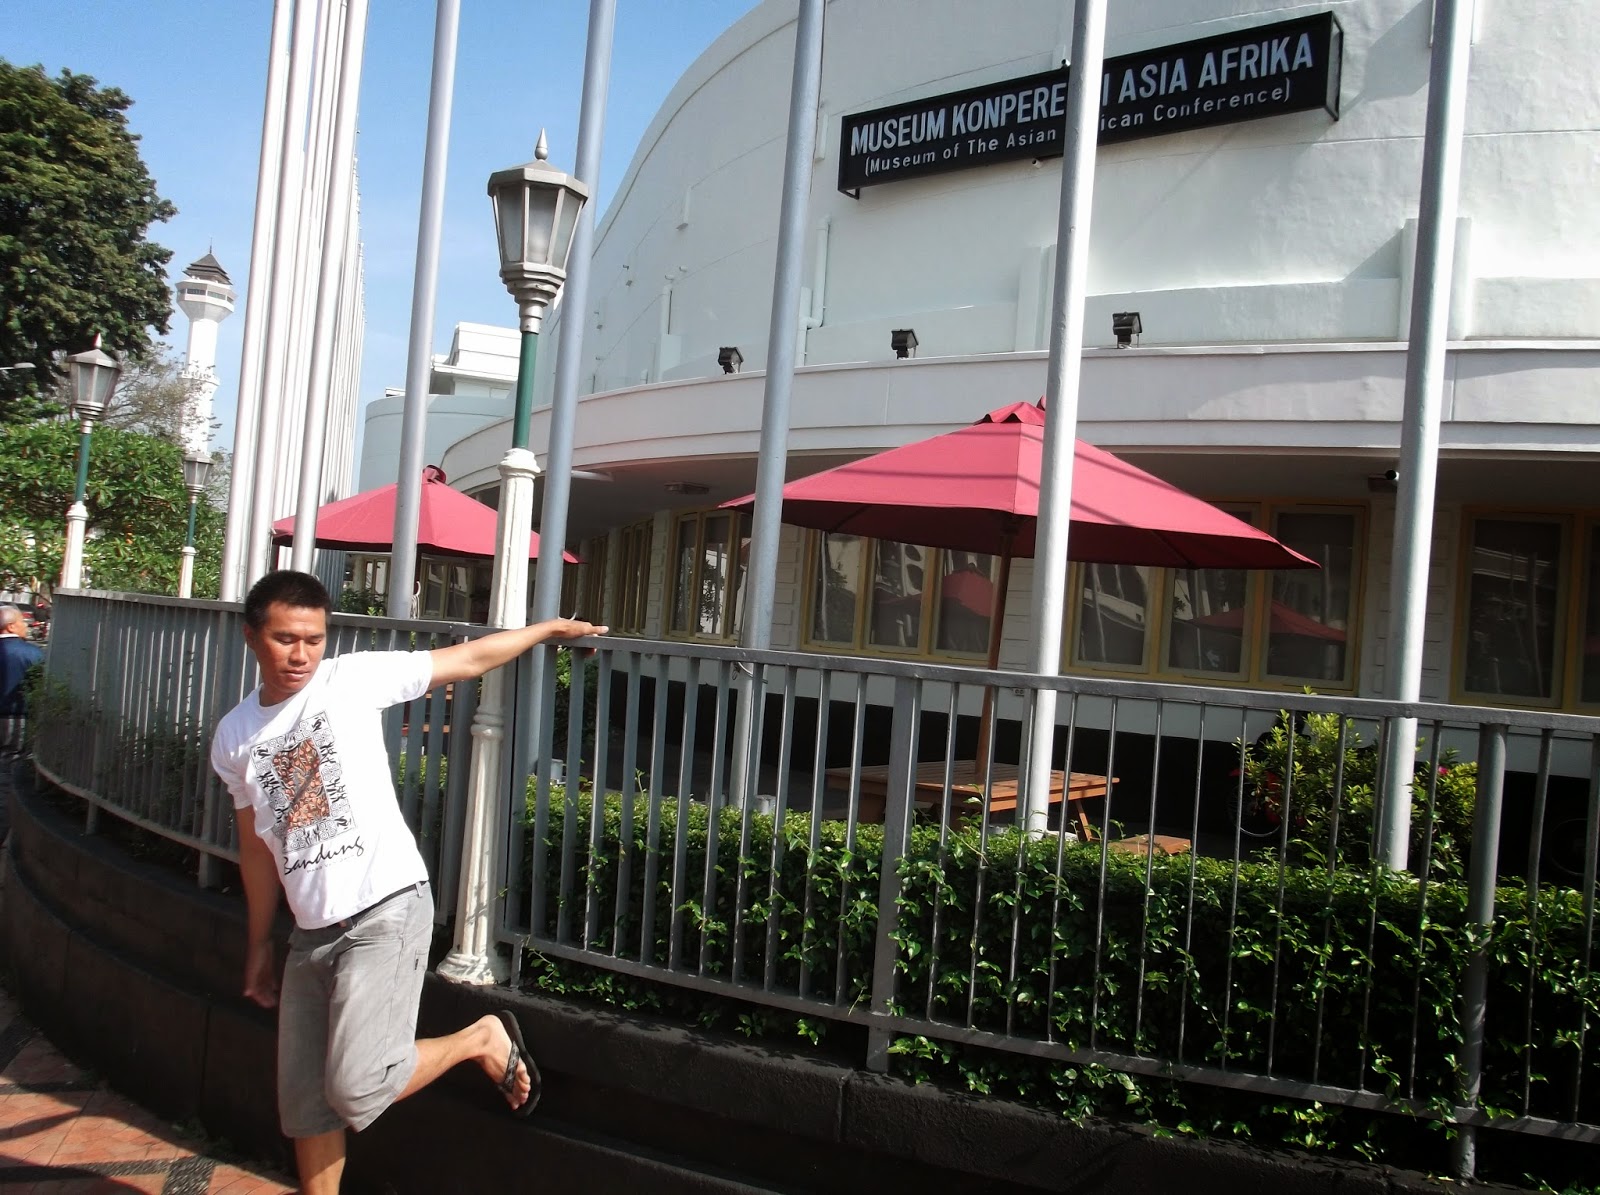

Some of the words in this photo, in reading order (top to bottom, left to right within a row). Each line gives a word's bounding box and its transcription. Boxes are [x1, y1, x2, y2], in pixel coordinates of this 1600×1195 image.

[850, 108, 946, 156] MUSEUM
[951, 73, 1110, 136] KONPEREI
[1118, 58, 1188, 104] ASIA
[1198, 32, 1314, 89] AFRIKA
[865, 151, 936, 177] (Museum
[943, 143, 960, 159] of
[968, 138, 999, 155] The
[1006, 128, 1056, 148] Asian
[1153, 77, 1290, 122] Conference)
[283, 835, 364, 876] Bandung
